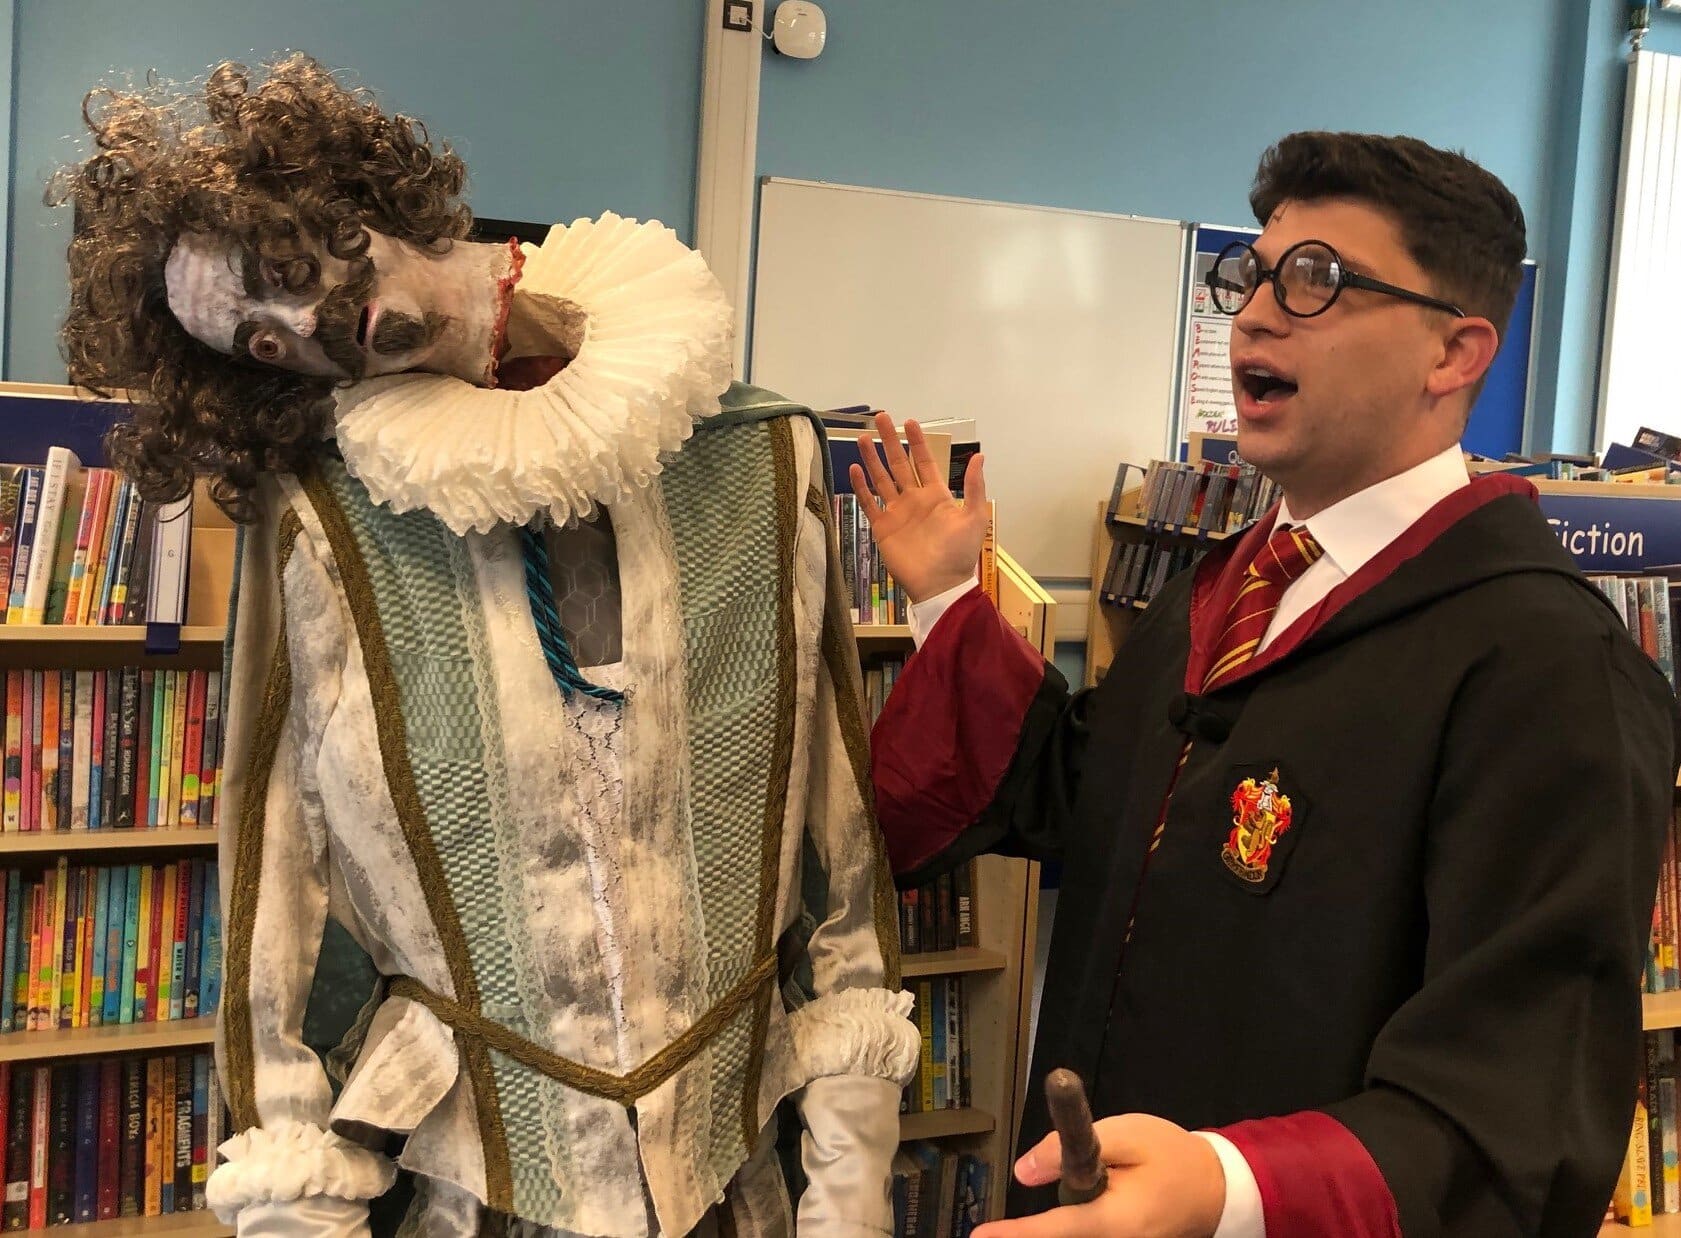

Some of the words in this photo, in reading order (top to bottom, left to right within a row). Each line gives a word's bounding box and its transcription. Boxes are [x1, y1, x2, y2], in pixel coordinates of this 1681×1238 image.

[45, 482, 59, 511] STAY
[167, 549, 175, 558] G
[959, 912, 970, 934] ANGEL
[177, 1099, 192, 1168] FRAGMENTS
